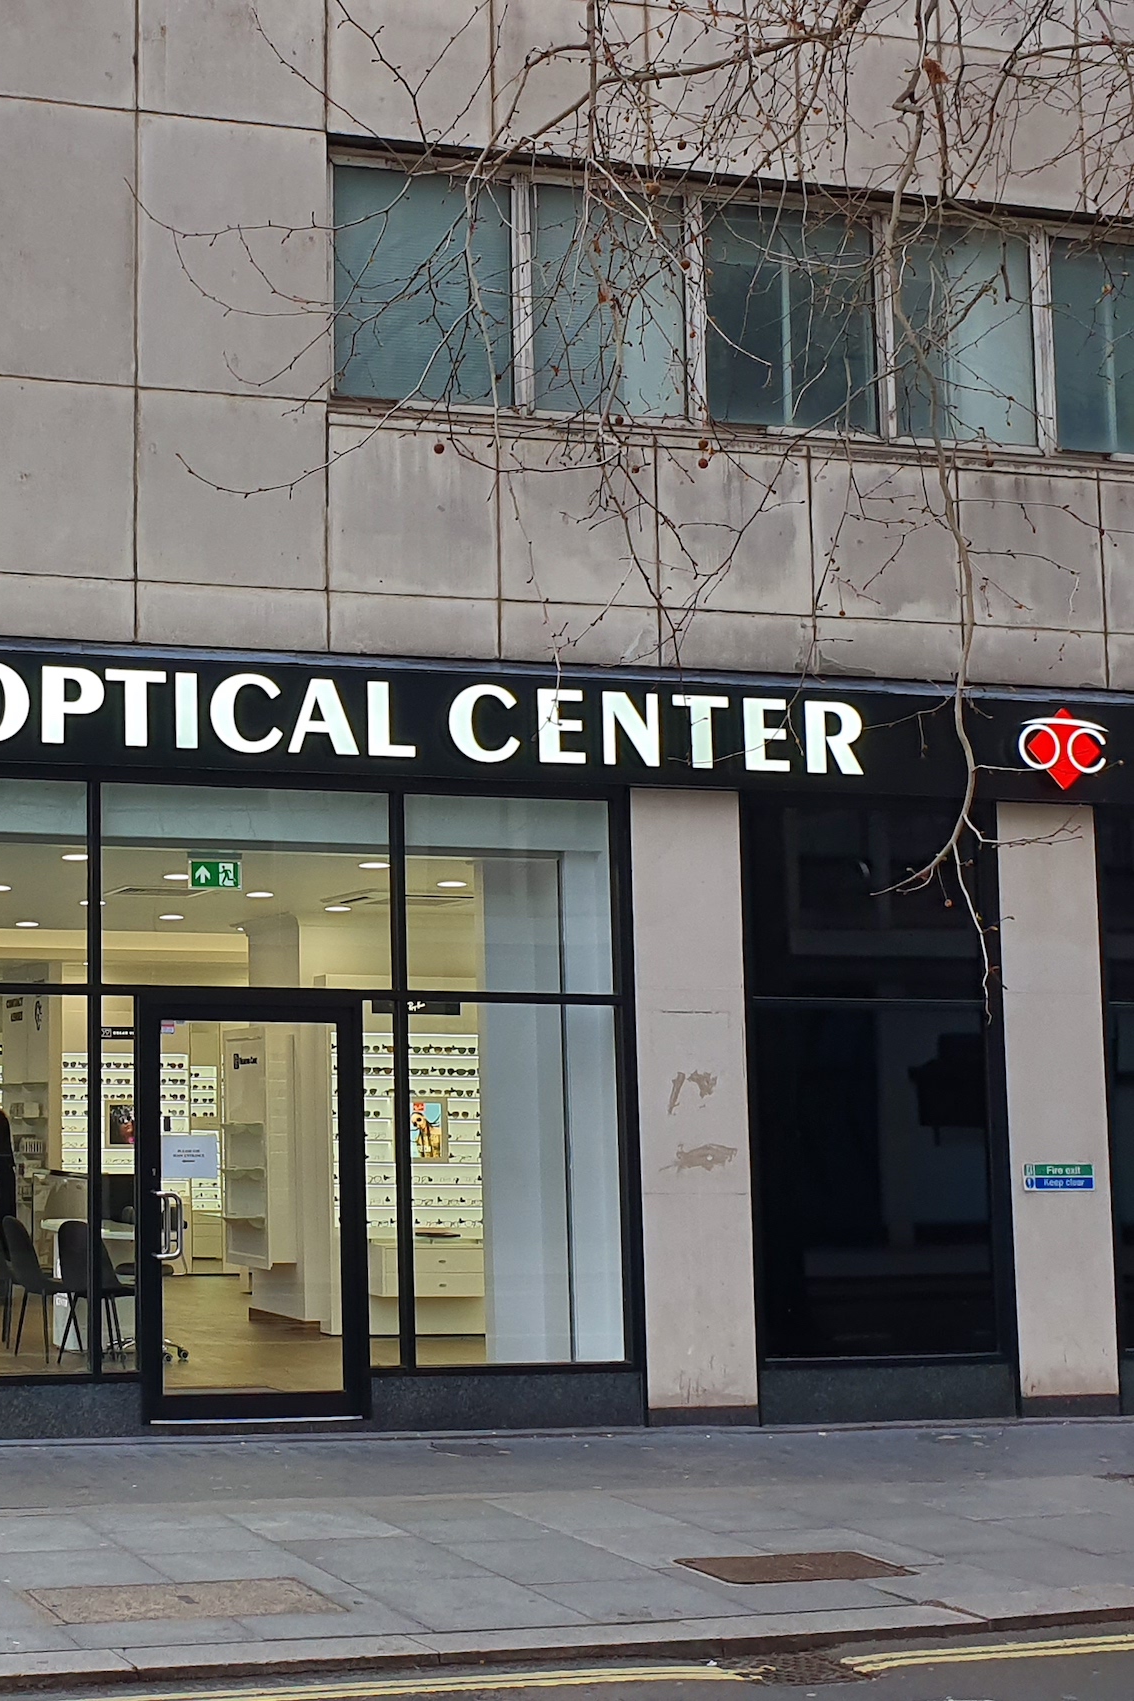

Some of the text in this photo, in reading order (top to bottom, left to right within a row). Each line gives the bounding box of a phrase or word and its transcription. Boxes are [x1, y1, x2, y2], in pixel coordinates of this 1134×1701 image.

[449, 683, 864, 776] CENTER
[1046, 1166, 1081, 1175] Fire exit
[1043, 1178, 1085, 1188] Keep clear
